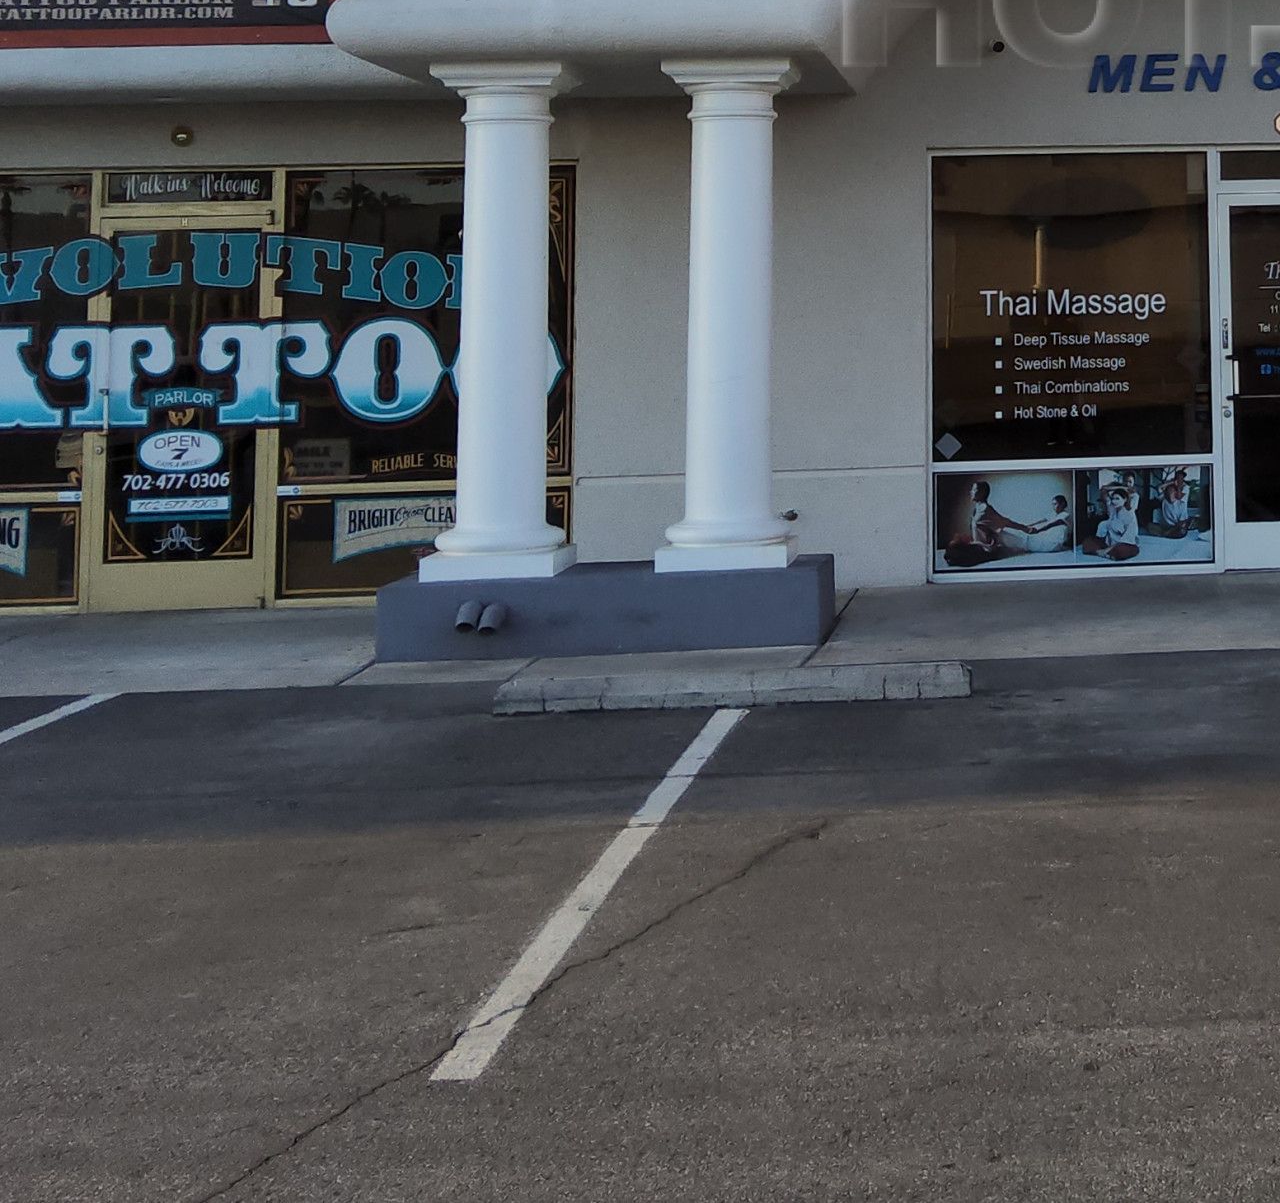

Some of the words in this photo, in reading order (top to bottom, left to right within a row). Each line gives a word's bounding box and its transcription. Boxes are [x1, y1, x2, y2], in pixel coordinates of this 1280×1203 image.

[1088, 53, 1226, 95] MEN
[201, 172, 261, 199] Welcome
[0, 232, 463, 310] VOLUTIO
[979, 288, 1037, 317] Thai
[1047, 288, 1167, 321] Massage
[1270, 305, 1279, 314] 11
[1258, 323, 1271, 333] Tel
[1014, 333, 1047, 348] Deep
[1050, 332, 1091, 345] Tissue
[1094, 331, 1150, 346] Massage
[1014, 356, 1067, 371] Swedish
[1070, 355, 1126, 371] Massage
[0, 317, 565, 428] TTO
[1014, 380, 1041, 395] Thai
[1045, 380, 1130, 394] Combinations
[154, 390, 213, 407] PARLOR
[1014, 405, 1033, 419] Hot
[1036, 405, 1068, 418] Stone
[1070, 405, 1079, 417] &
[1081, 404, 1097, 417] Oil
[154, 435, 201, 449] OPEN
[171, 448, 189, 461] 7
[371, 452, 425, 474] RELIABLE
[347, 507, 398, 535] BRIGHT
[424, 505, 456, 524] CLEA
